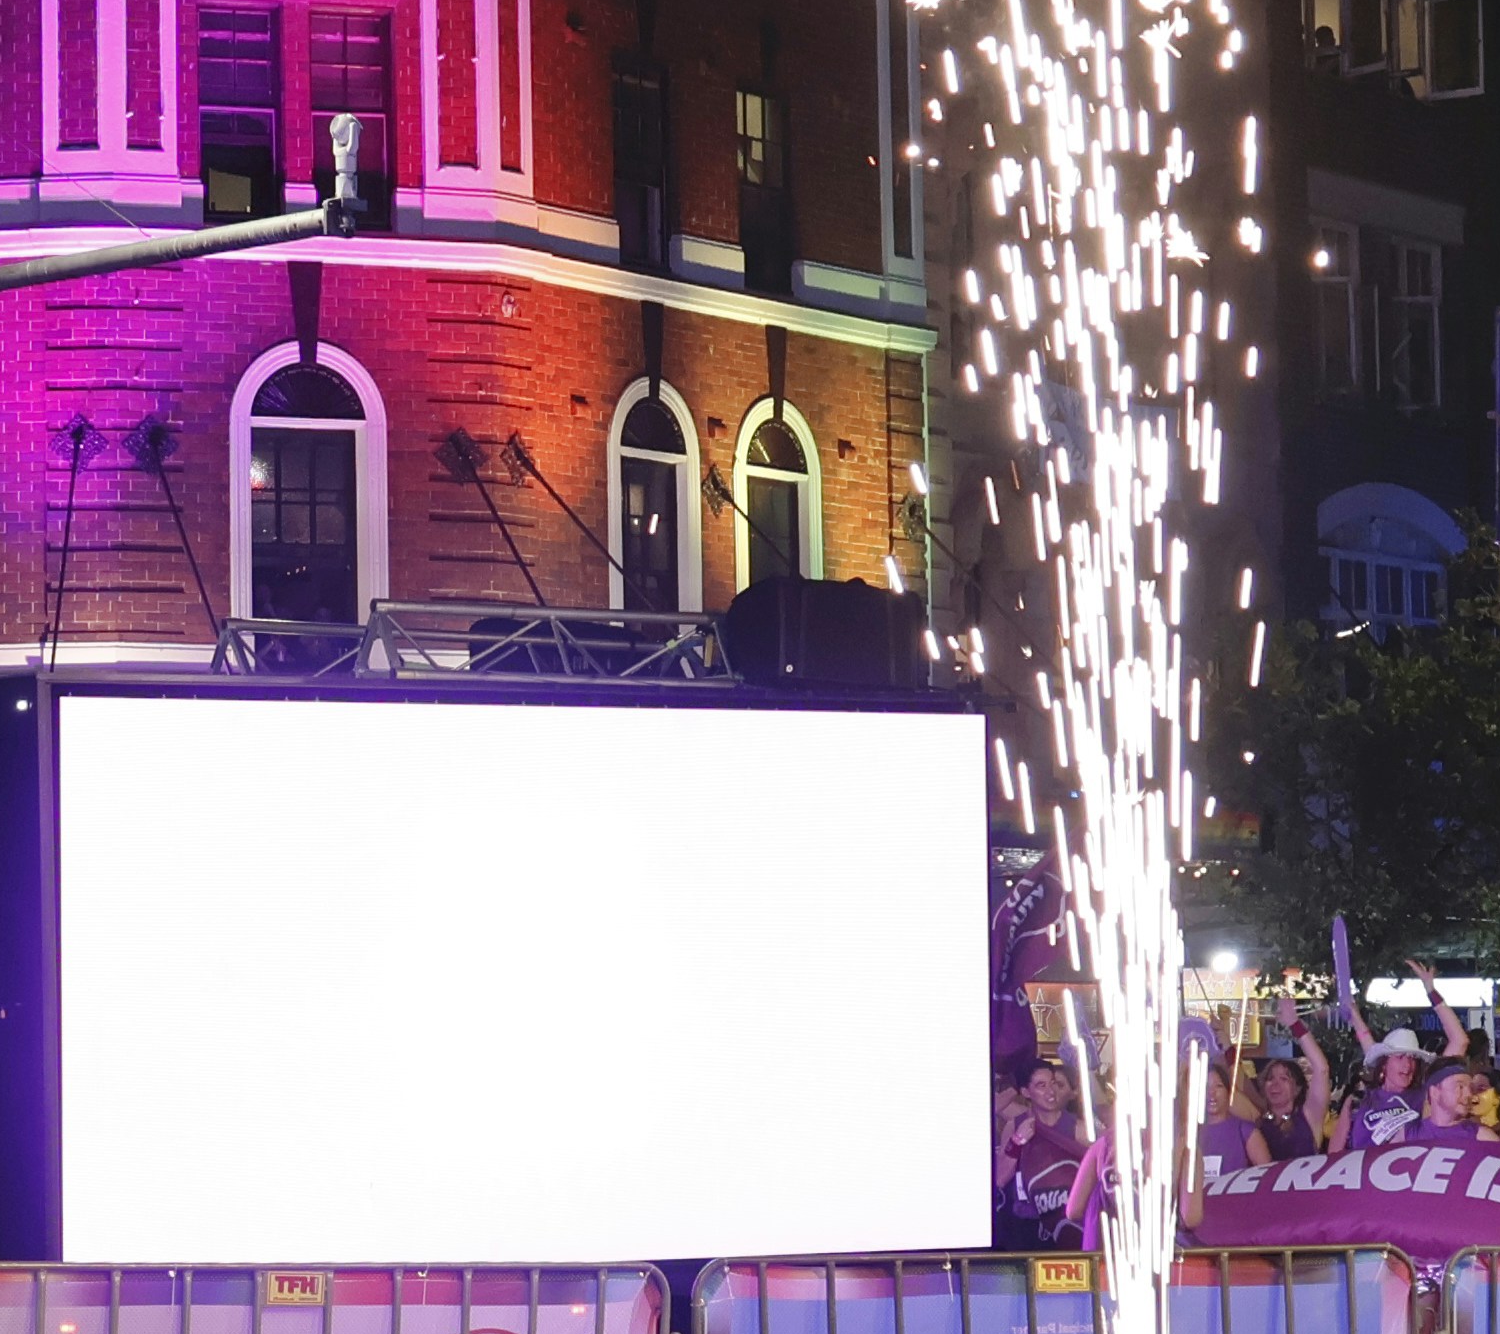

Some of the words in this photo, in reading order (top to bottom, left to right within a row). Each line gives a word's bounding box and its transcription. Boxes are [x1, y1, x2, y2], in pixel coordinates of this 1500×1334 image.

[1203, 1161, 1279, 1196] HE
[1273, 1146, 1465, 1194] RACE
[1041, 1263, 1080, 1281] TFH
[275, 1275, 316, 1294] TFH
